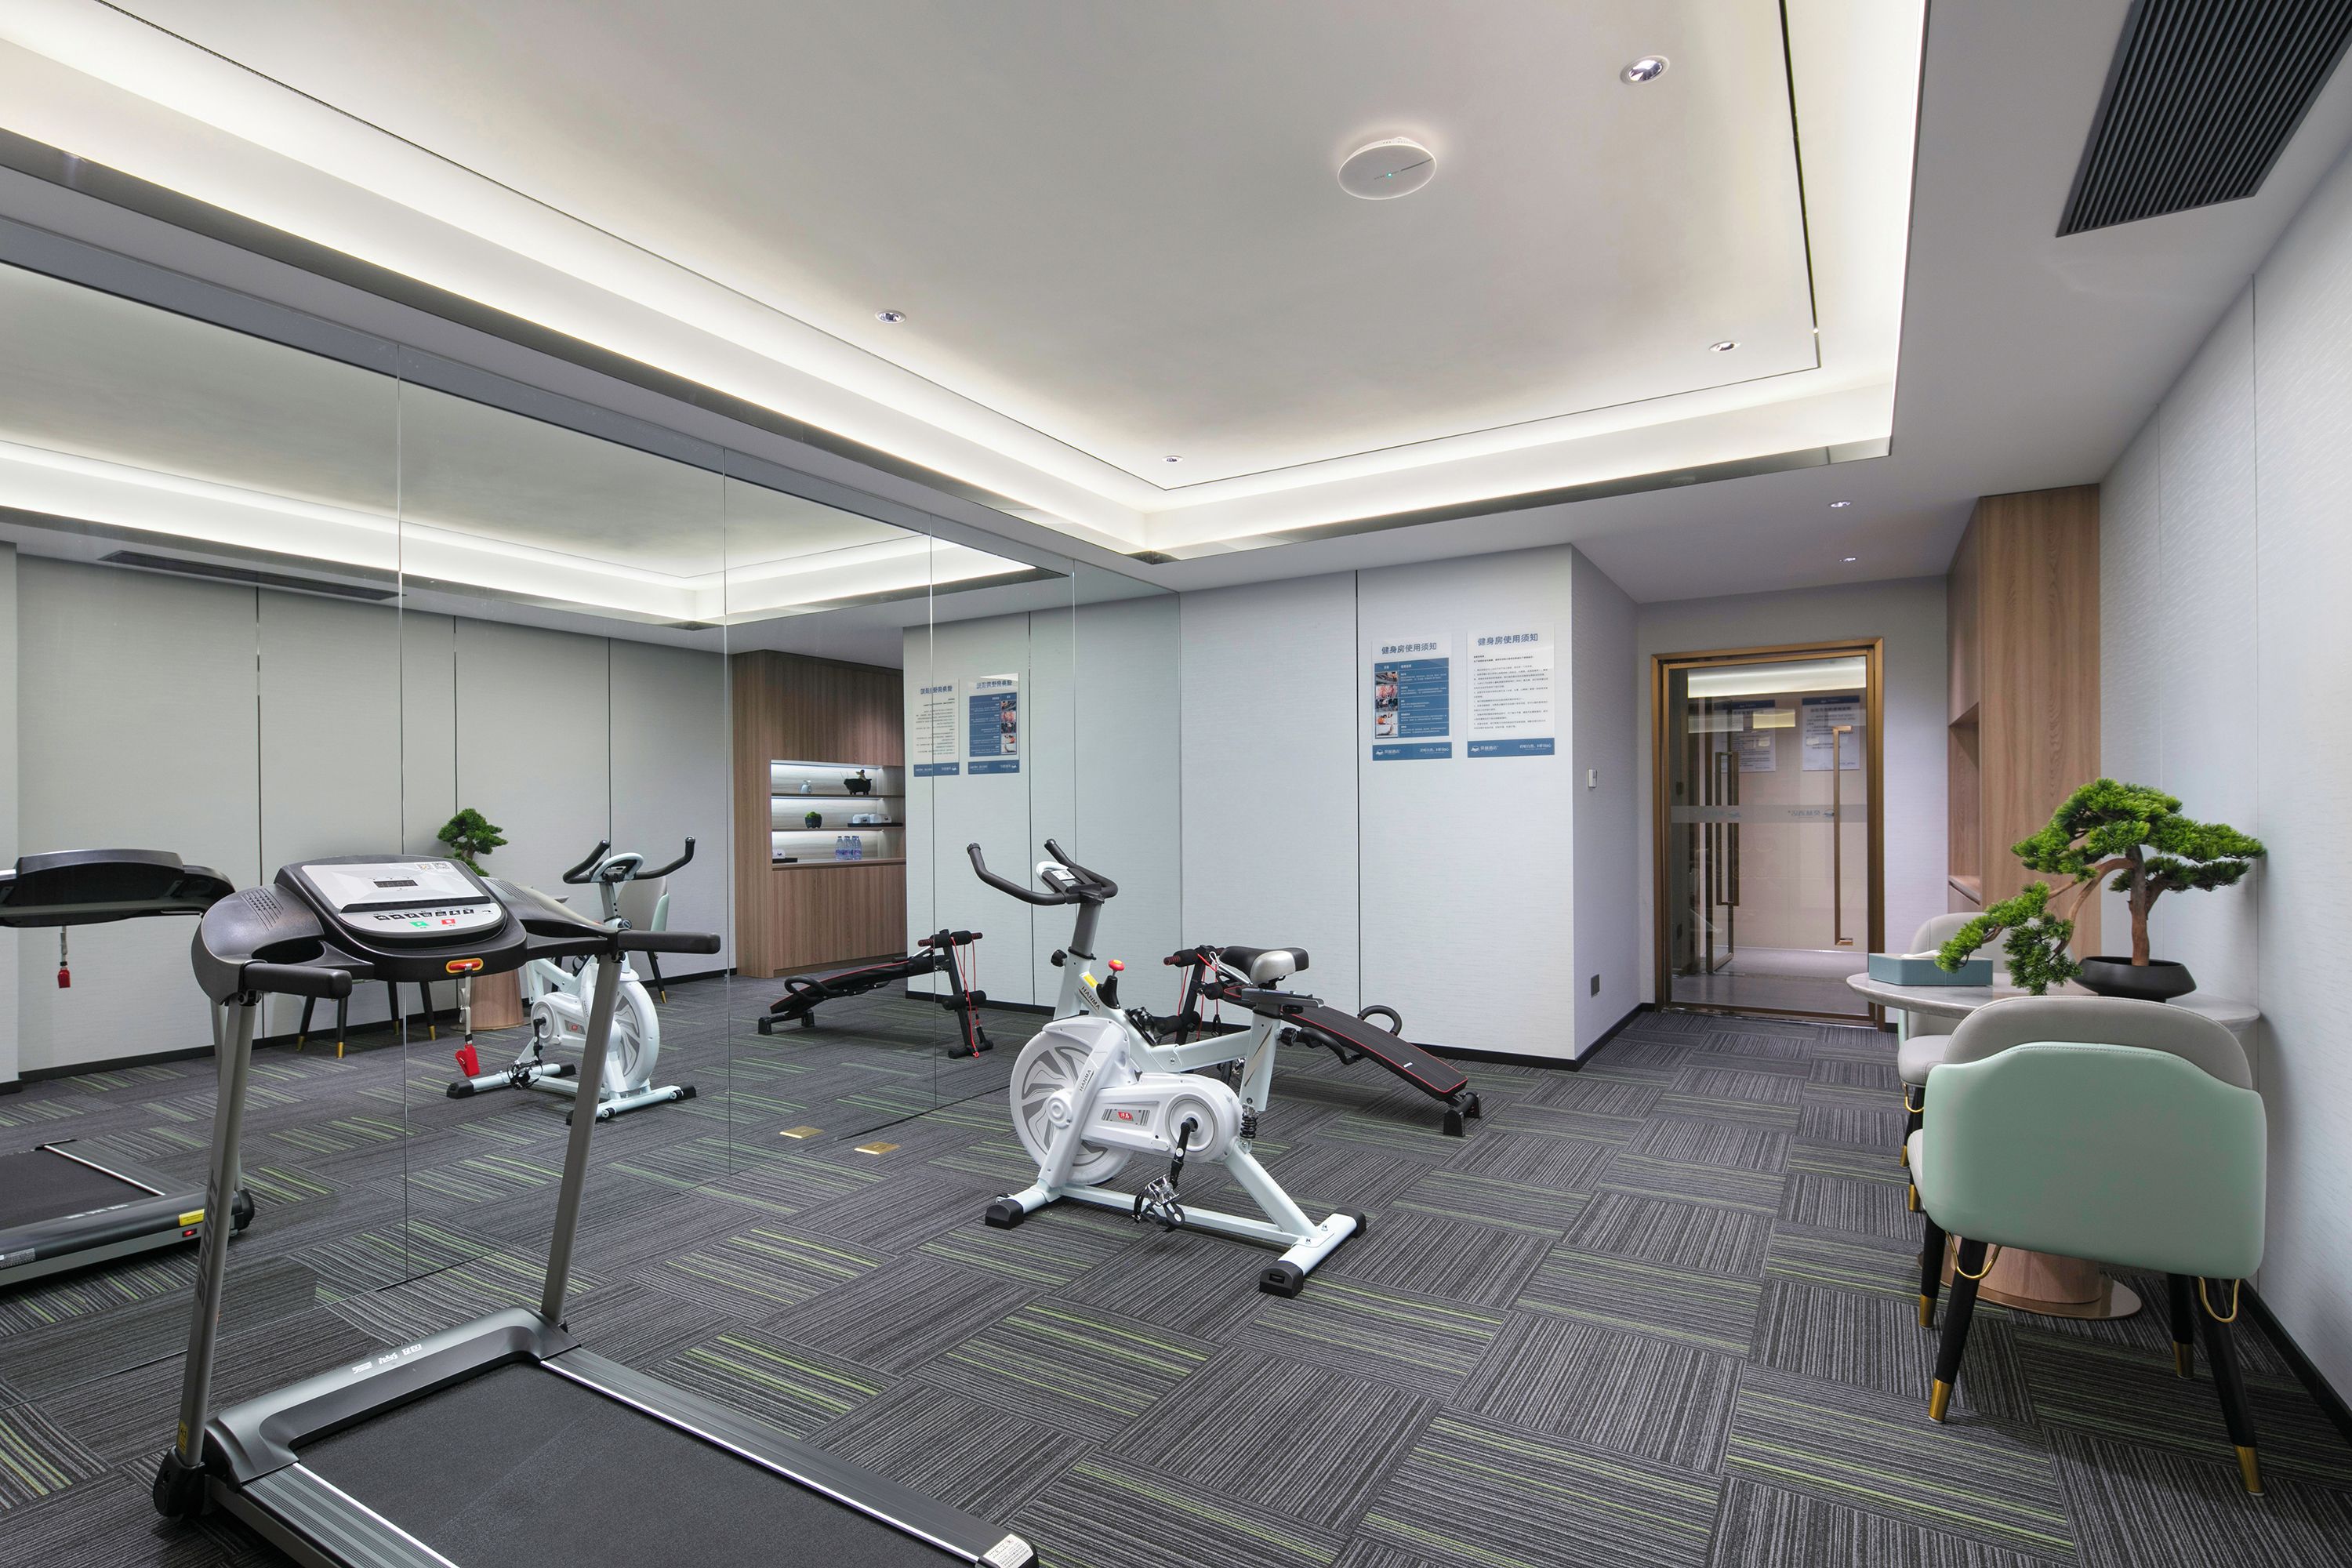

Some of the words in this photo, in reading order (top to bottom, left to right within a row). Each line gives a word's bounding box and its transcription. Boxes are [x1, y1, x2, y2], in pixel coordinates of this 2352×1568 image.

[1381, 642, 1437, 655] 健身房使用须知
[1478, 633, 1538, 646] 健身房使用须知
[1081, 985, 1100, 1011] HANMA
[1080, 1069, 1091, 1092] HANMA
[197, 1167, 218, 1308] SPORT
